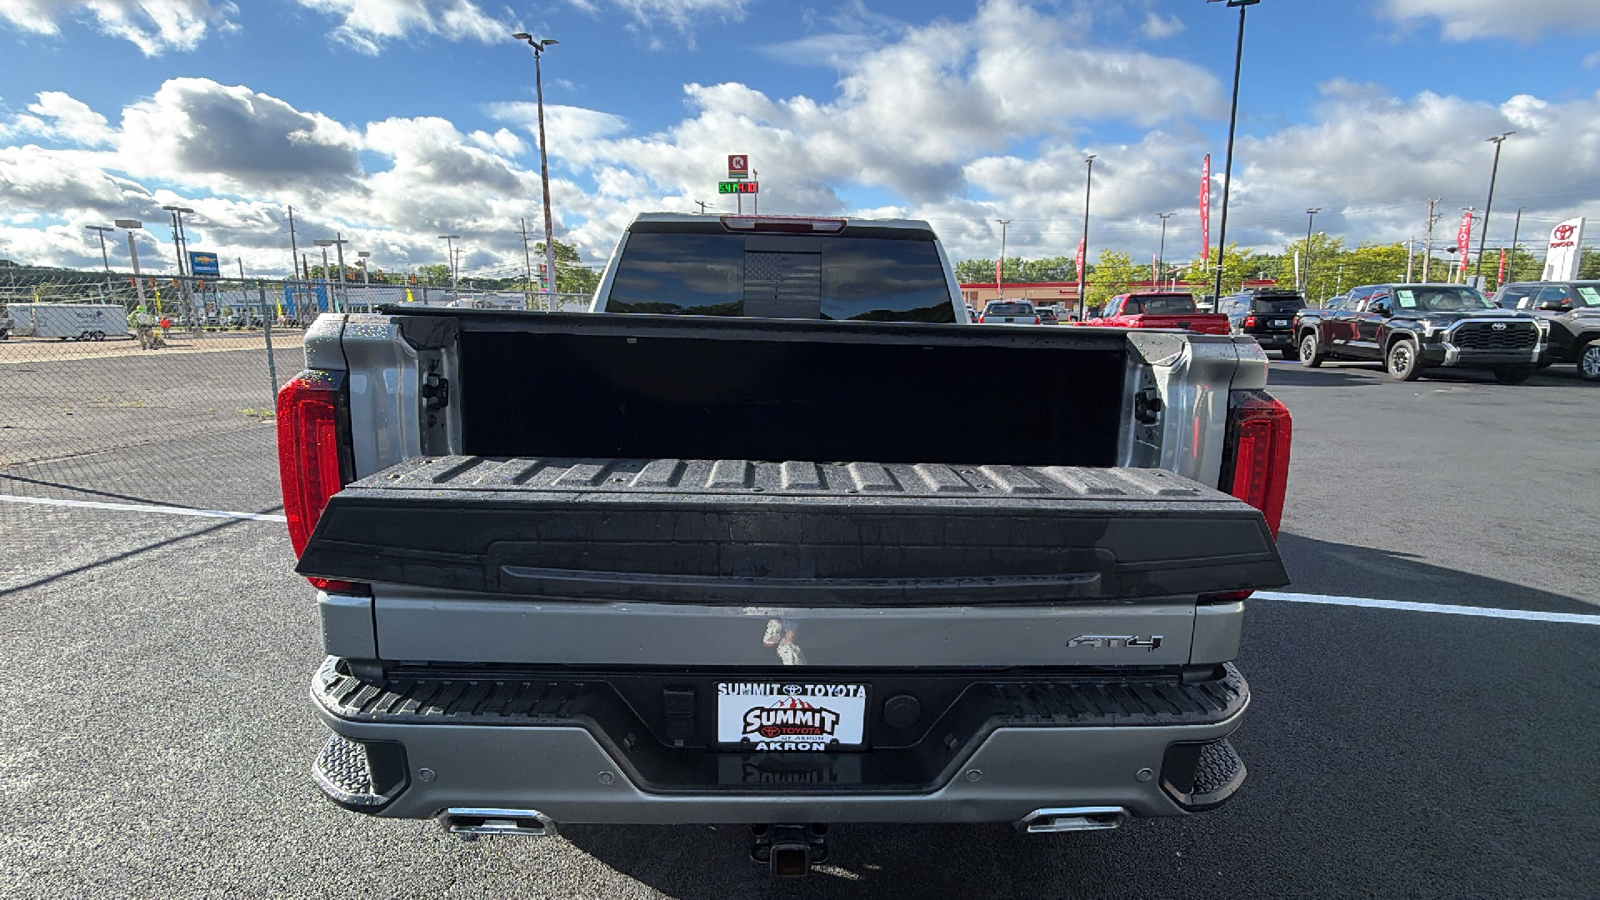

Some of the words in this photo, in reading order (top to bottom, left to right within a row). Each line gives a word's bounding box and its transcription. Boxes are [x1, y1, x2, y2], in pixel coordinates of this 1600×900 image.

[1066, 635, 1164, 653] AT4
[718, 683, 780, 696] SUMMIT
[805, 684, 866, 698] TOYOTA
[743, 707, 838, 736] SUMMIT
[781, 727, 821, 735] TOYOTA
[756, 742, 825, 751] AKRON
